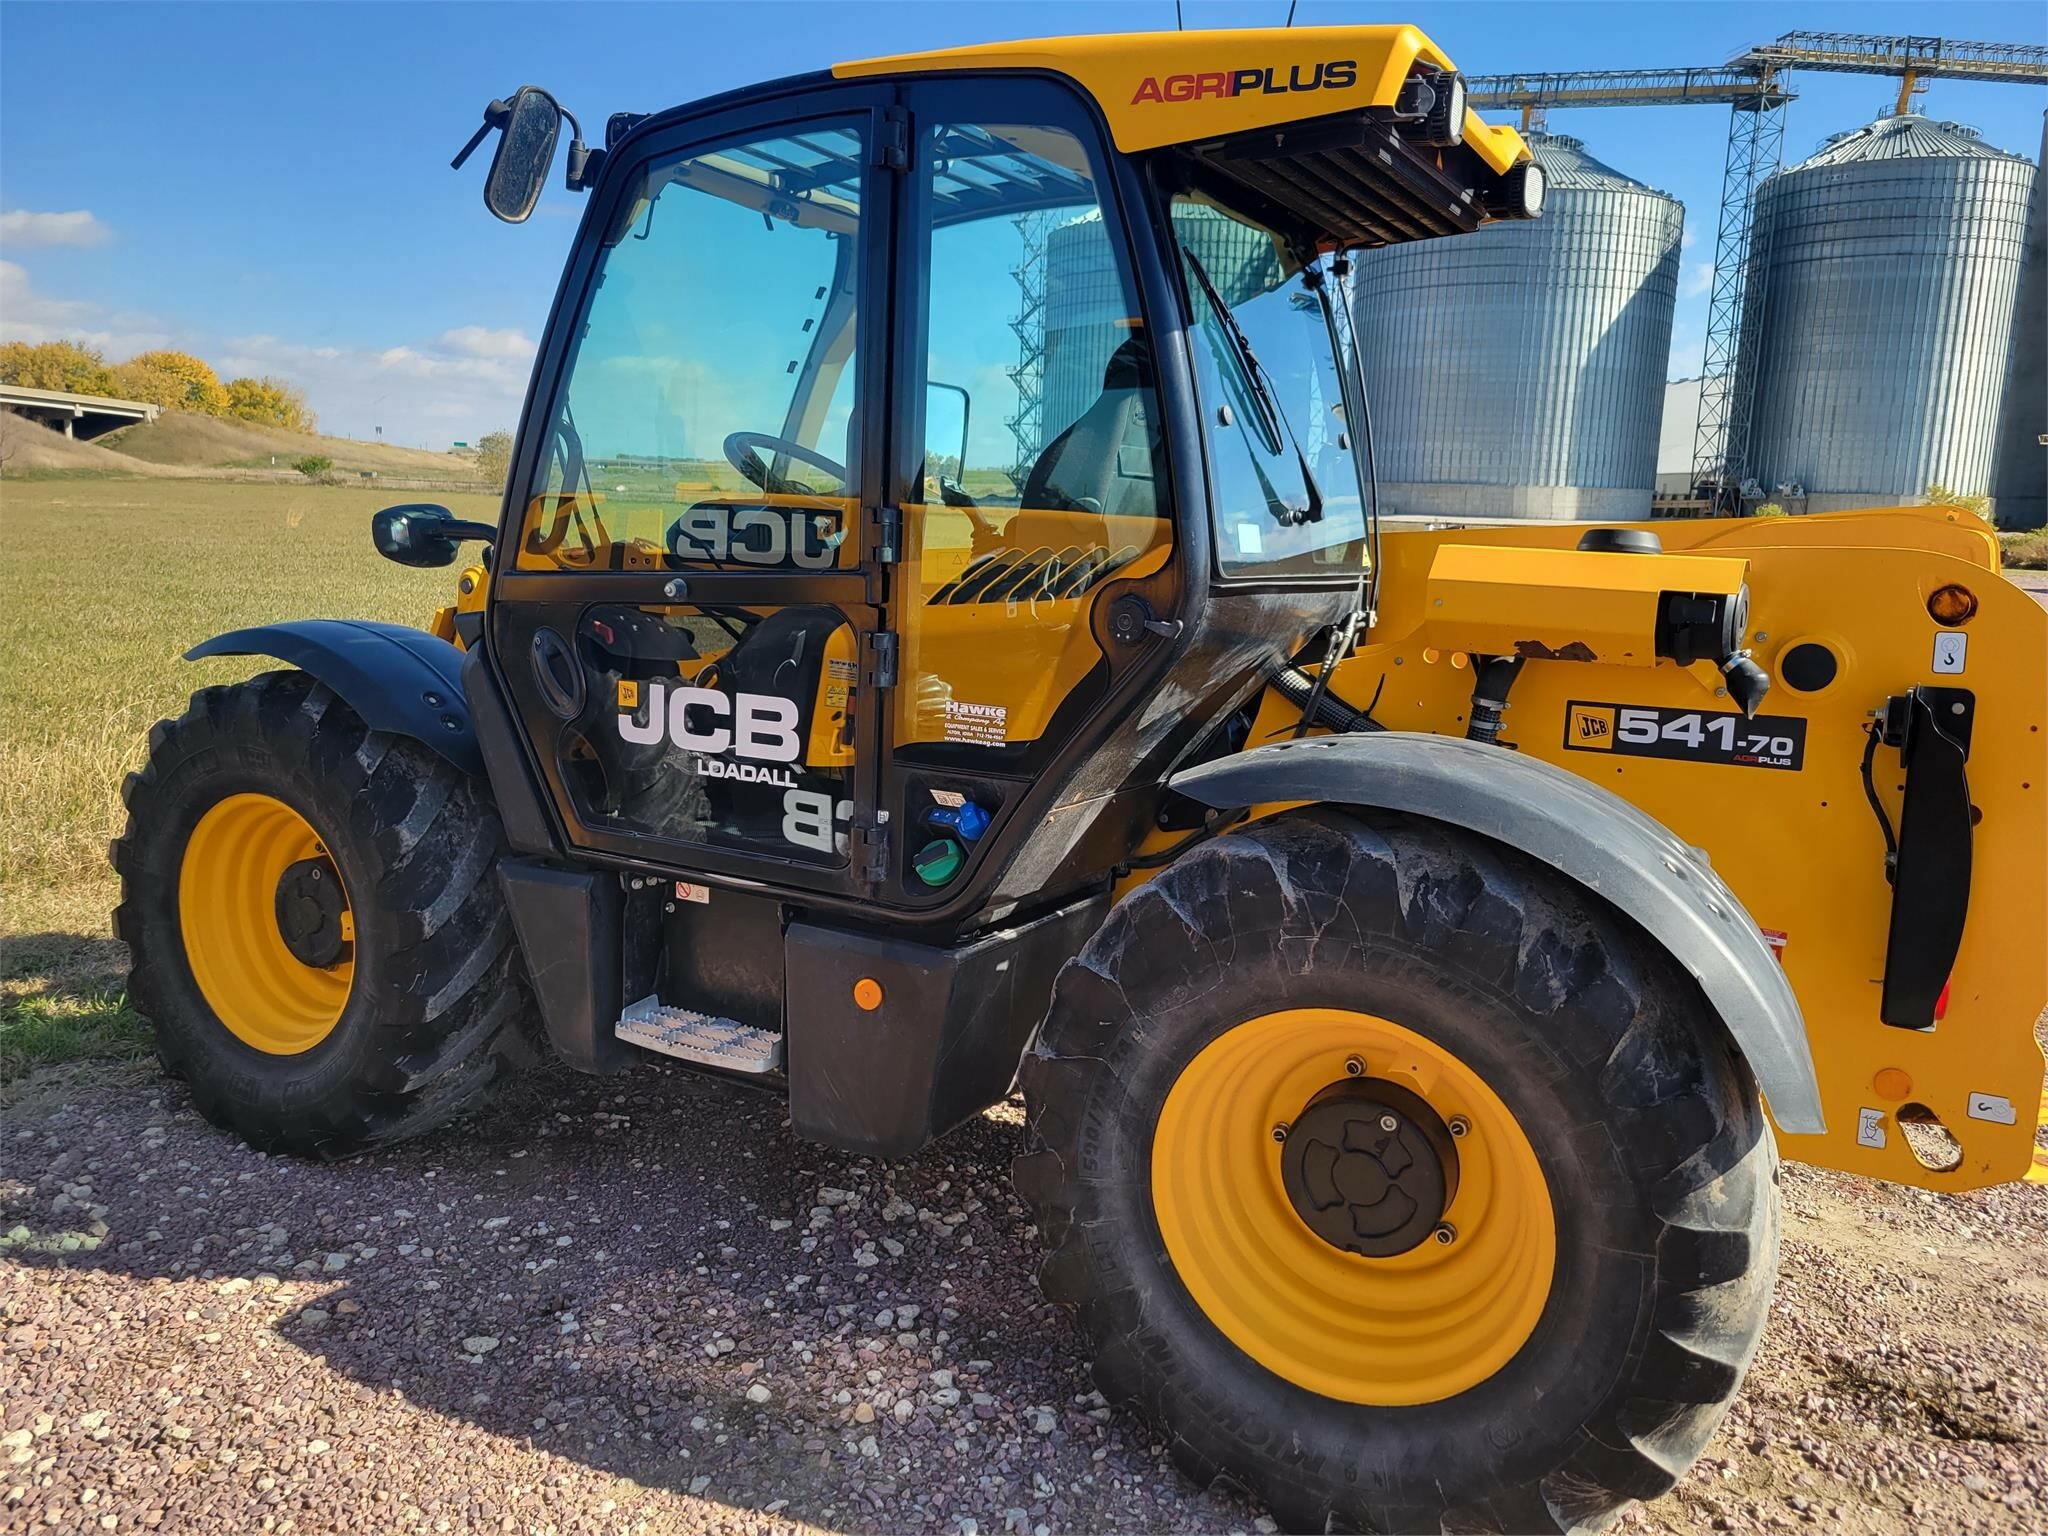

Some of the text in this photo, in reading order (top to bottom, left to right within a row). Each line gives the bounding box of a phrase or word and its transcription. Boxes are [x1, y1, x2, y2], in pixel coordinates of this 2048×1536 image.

[1130, 60, 1357, 105] AGRIPLUS
[945, 701, 1006, 717] Hawke
[618, 683, 800, 763] JCB
[1581, 715, 1608, 738] JCB
[1617, 708, 1793, 756] 541-70
[944, 736, 1006, 747] www.hawkeag.com
[1732, 753, 1792, 766] AGRIPLUS
[697, 759, 798, 788] LOADALL
